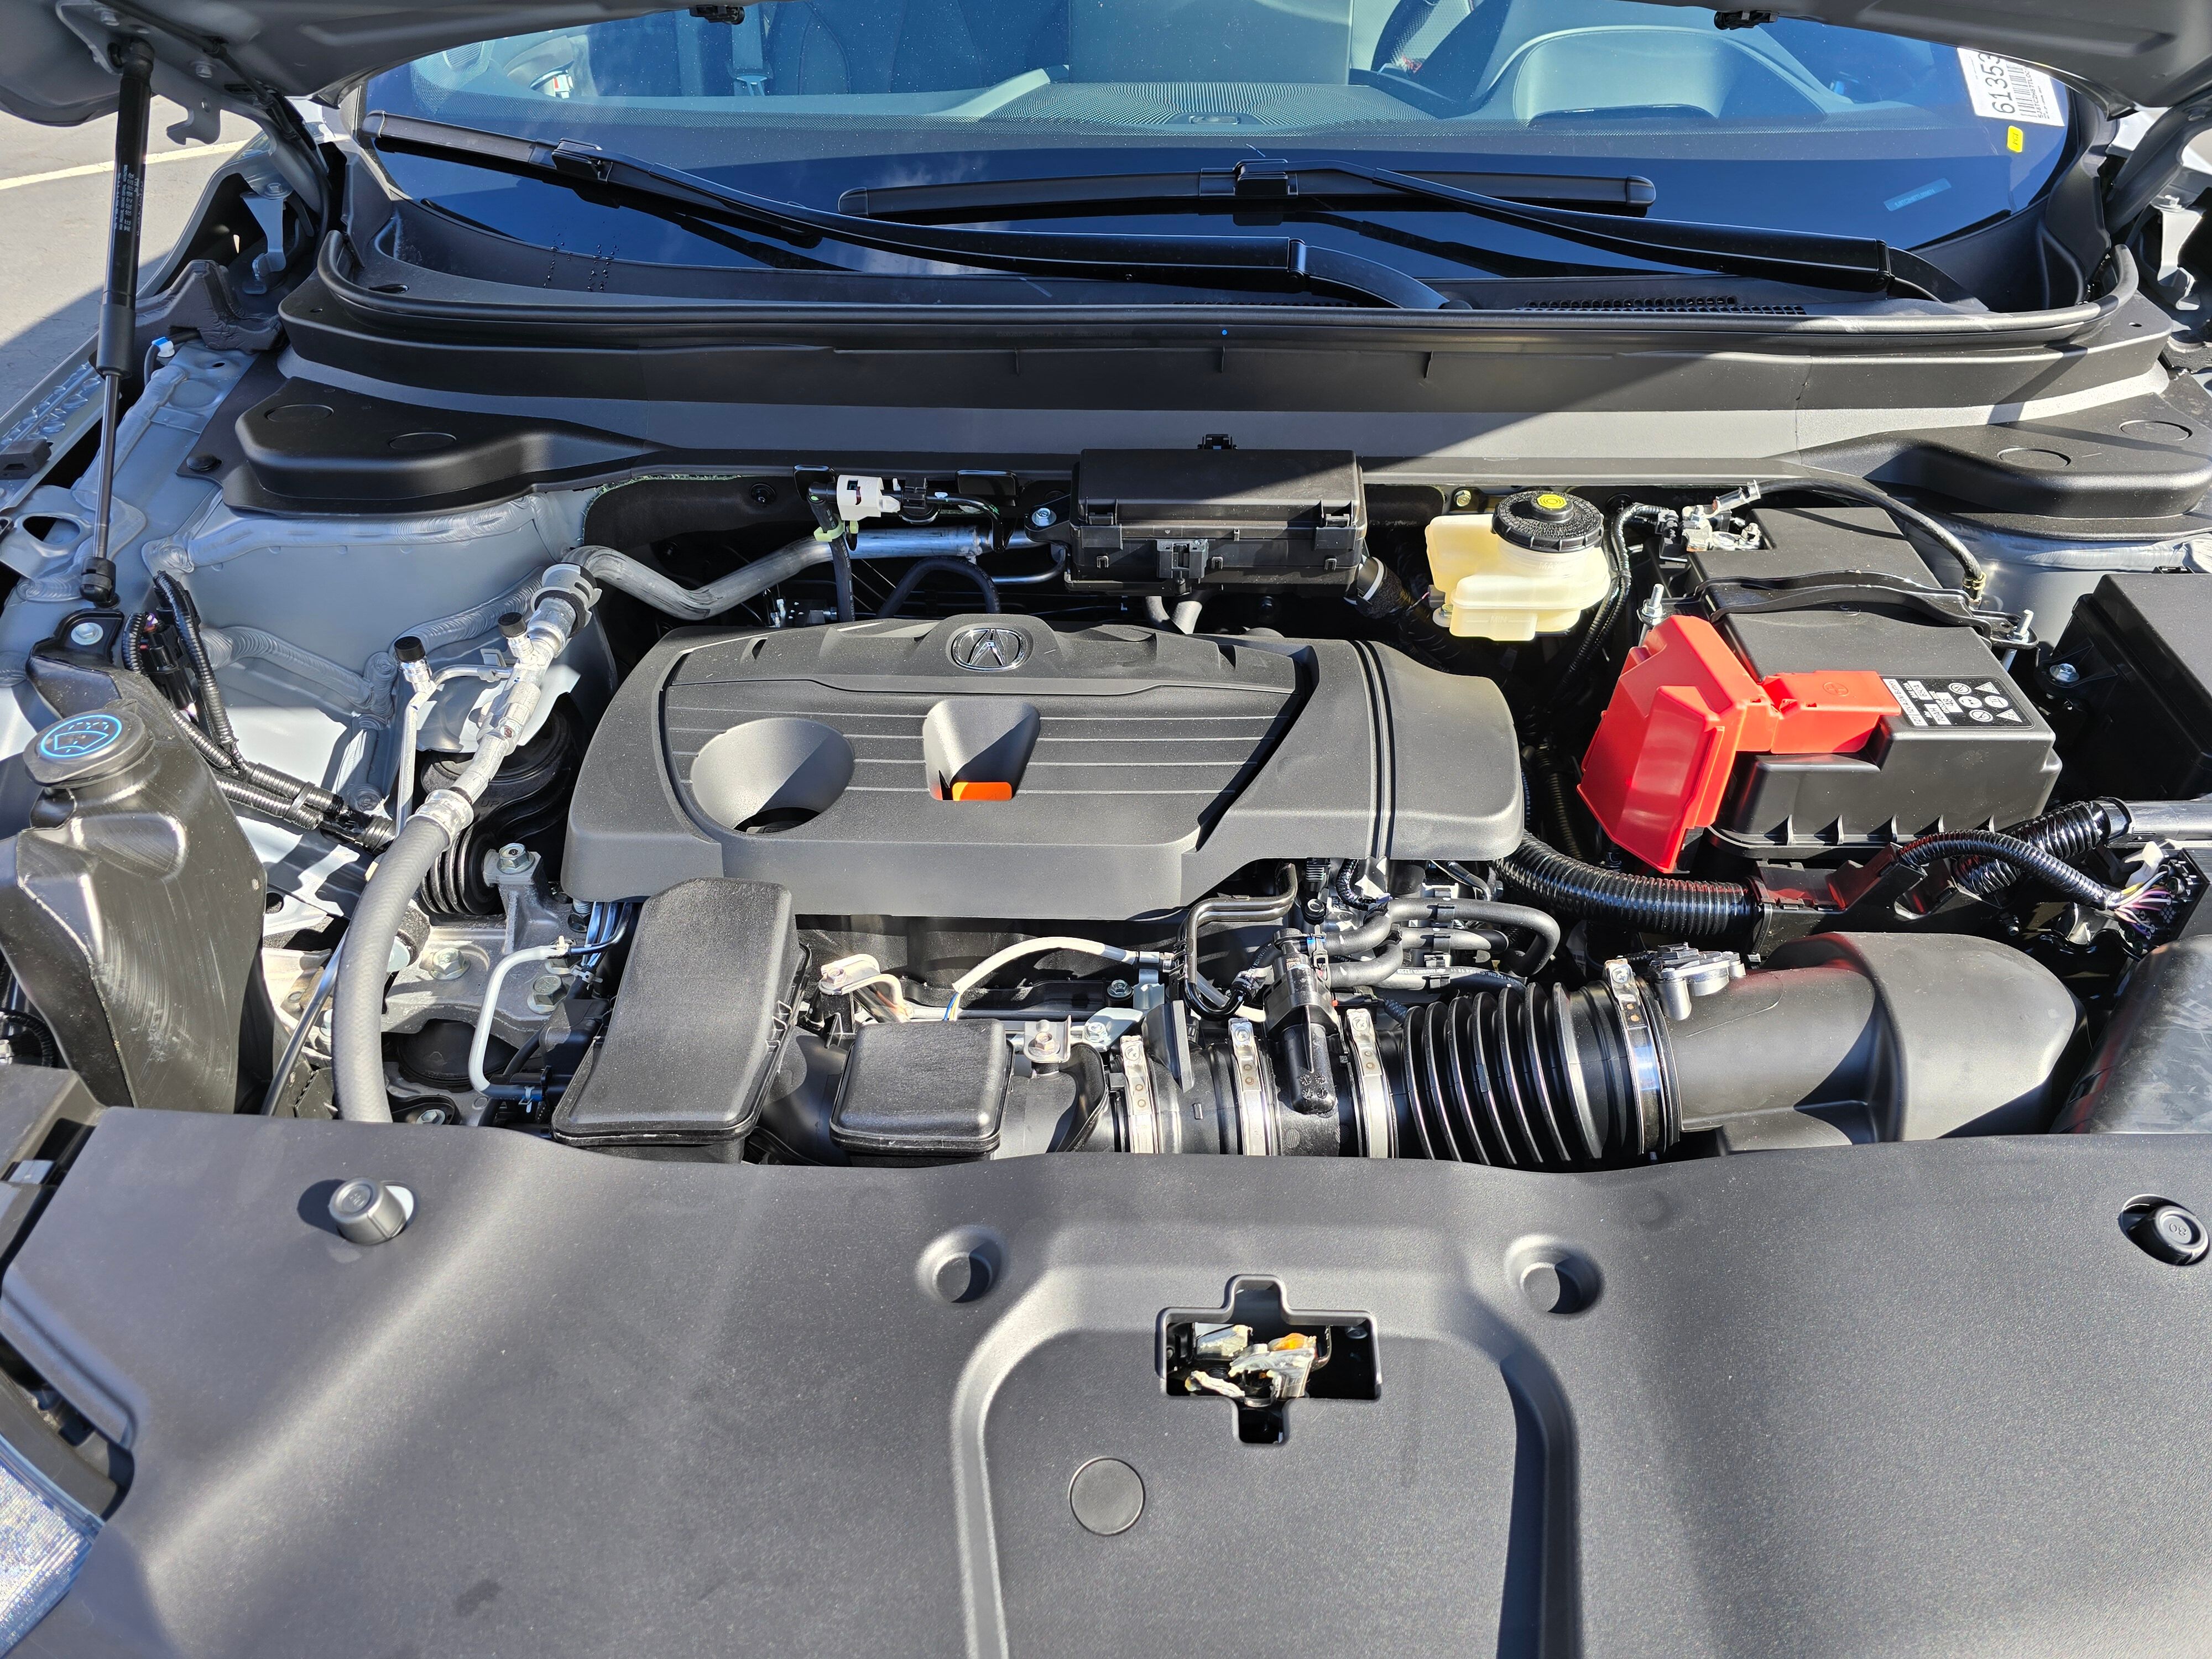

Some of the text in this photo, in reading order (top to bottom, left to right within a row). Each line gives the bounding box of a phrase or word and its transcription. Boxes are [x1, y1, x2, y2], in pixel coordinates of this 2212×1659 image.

[1978, 53, 2015, 114] 61353
[481, 800, 500, 808] UP
[2168, 1223, 2187, 1237] 30
